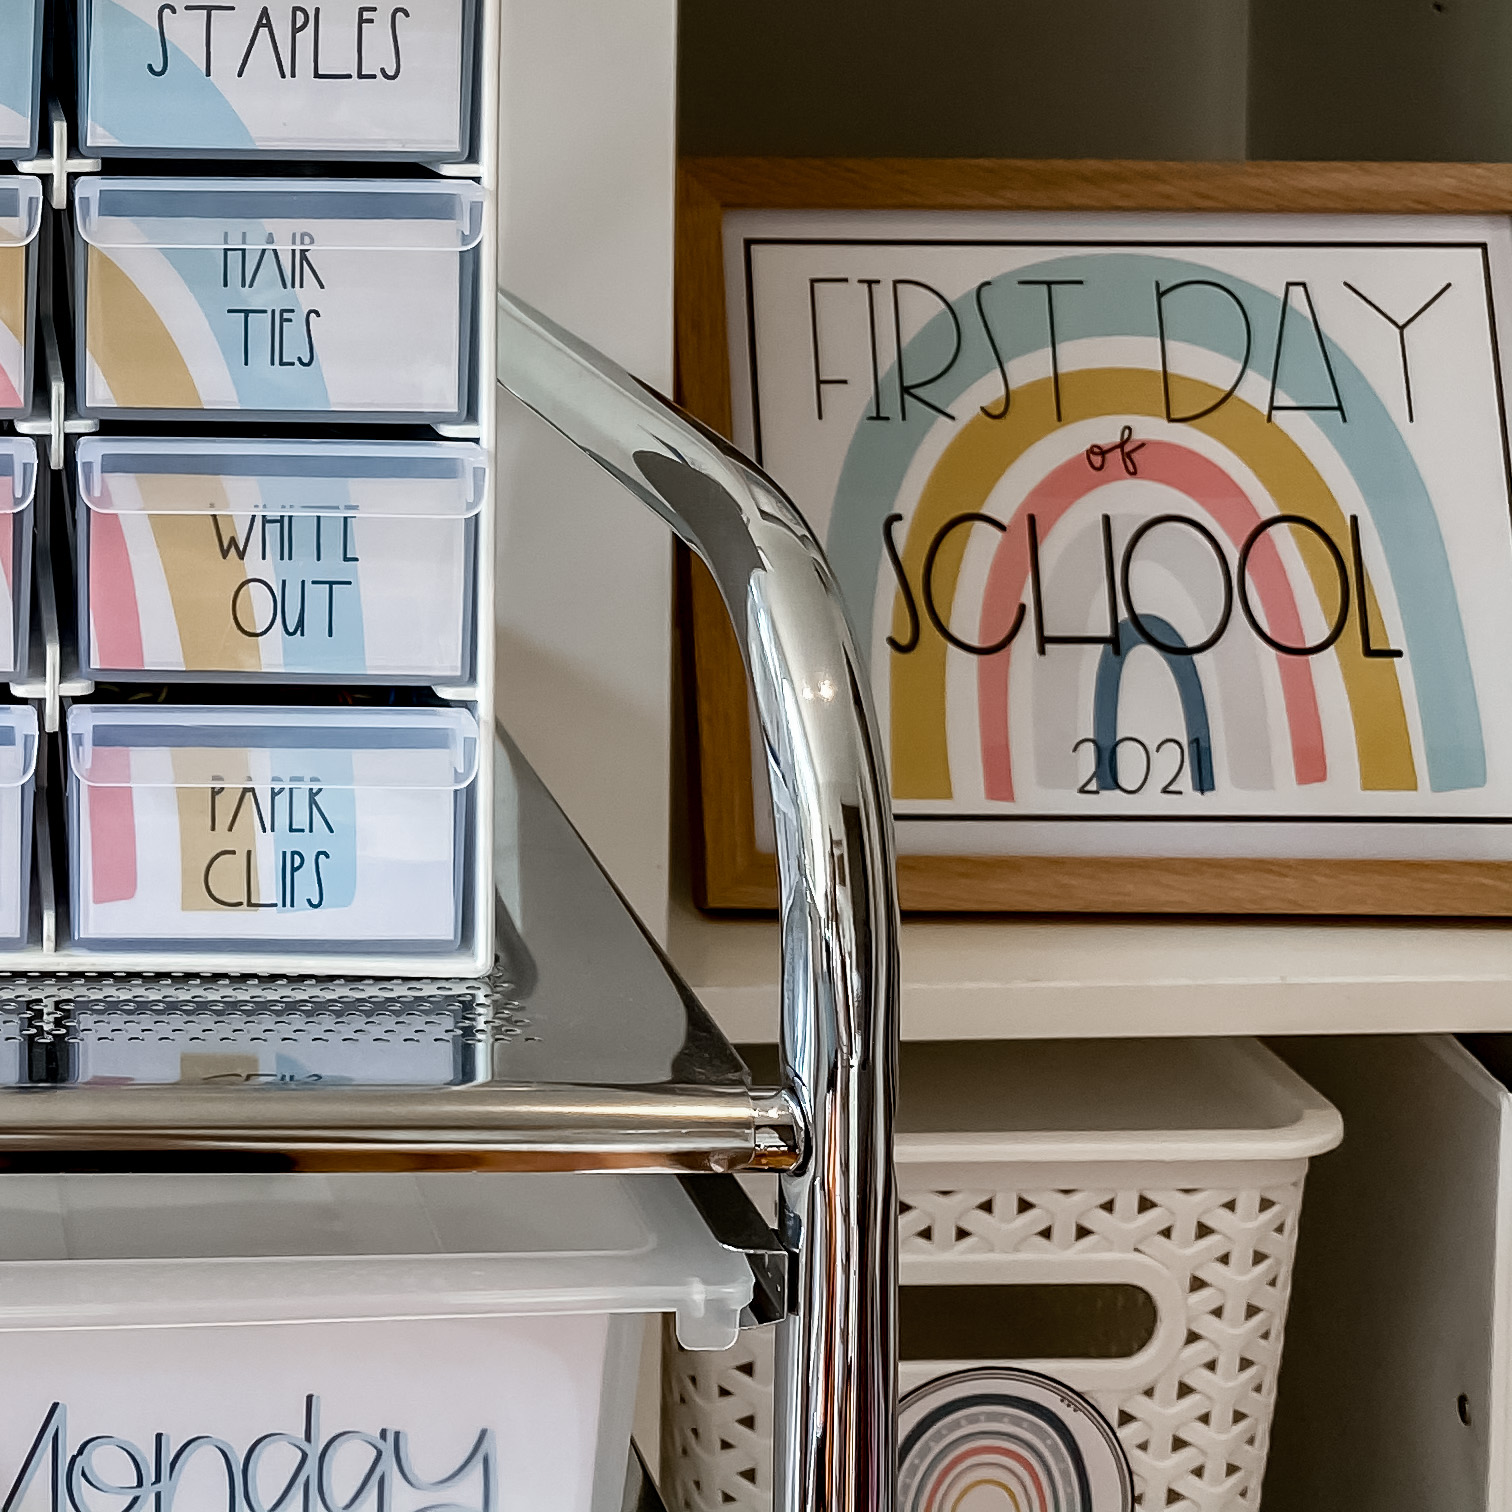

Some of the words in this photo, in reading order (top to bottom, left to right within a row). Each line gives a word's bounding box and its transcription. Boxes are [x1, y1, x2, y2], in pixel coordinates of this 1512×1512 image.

[146, 3, 411, 81] STAPLES
[222, 231, 326, 290] HAIR
[226, 308, 321, 368] TIES
[809, 277, 1084, 422] FIRST
[1155, 281, 1452, 423] DAY
[1086, 426, 1146, 476] of
[208, 502, 360, 563] WHITE
[231, 577, 352, 638] OUT
[883, 513, 1403, 658] SCHOOL
[1071, 737, 1207, 796] 2021
[210, 775, 334, 834] PAPER
[203, 850, 330, 910] CLIPS
